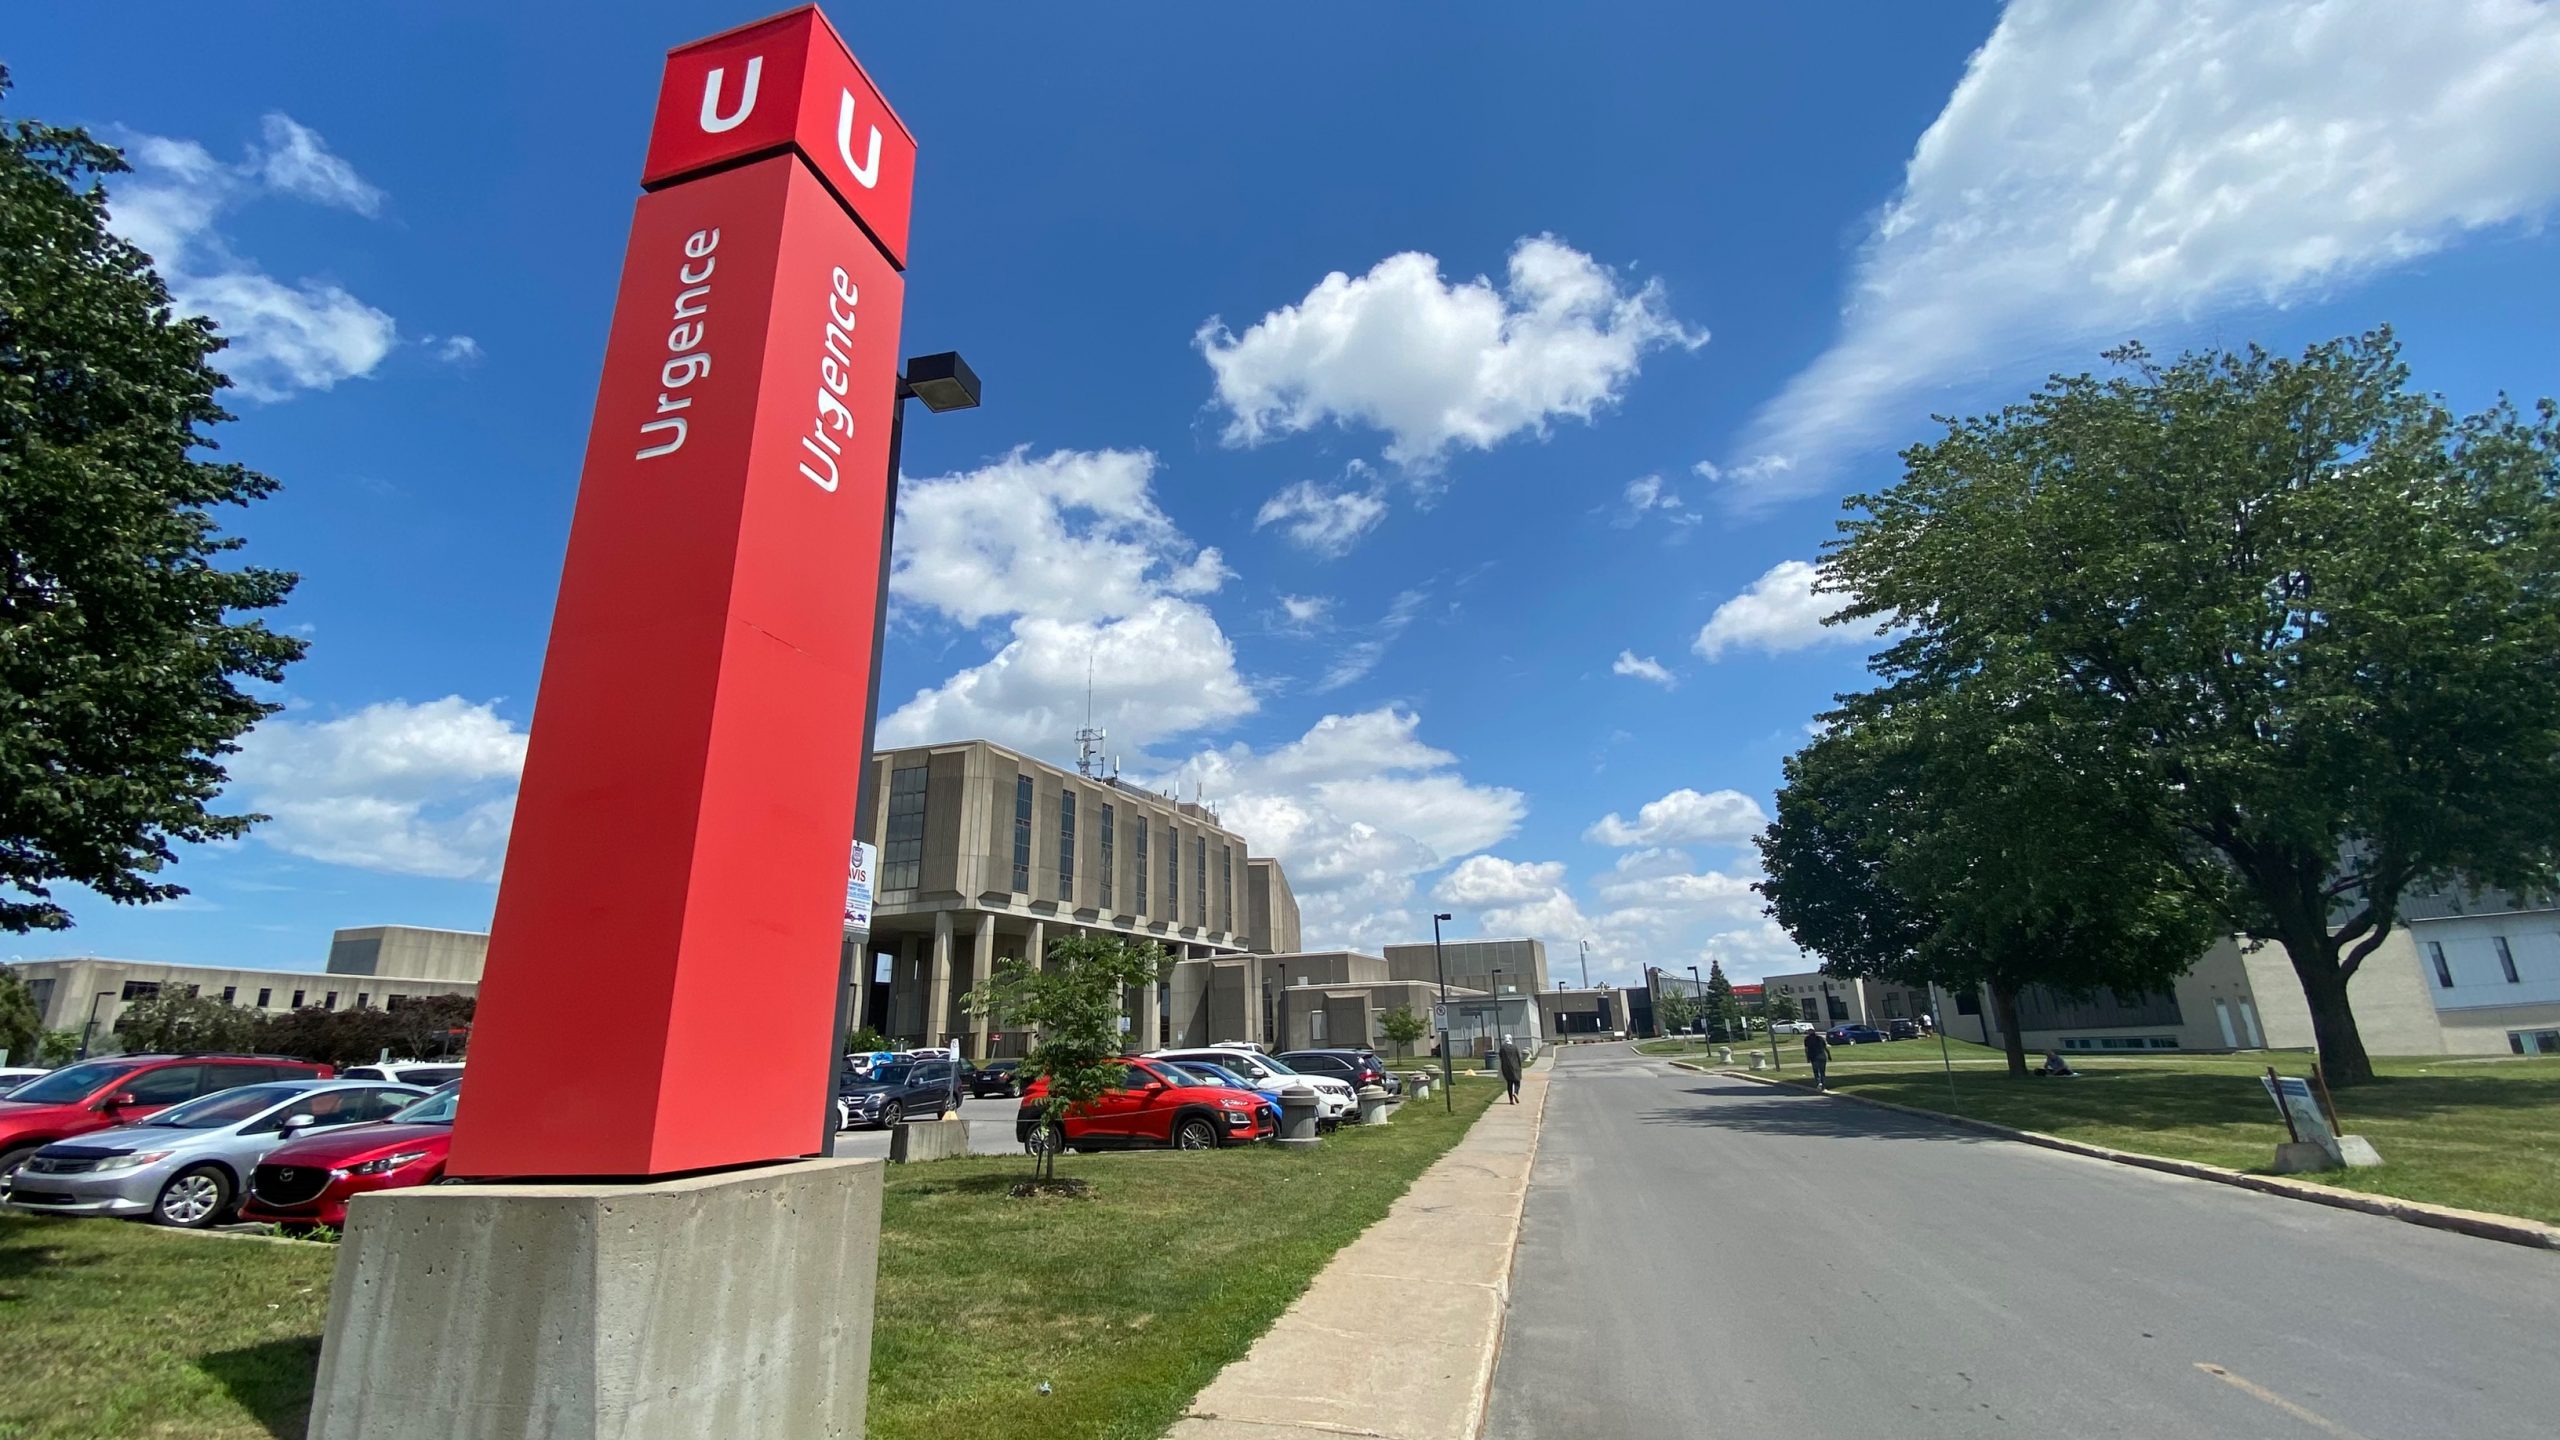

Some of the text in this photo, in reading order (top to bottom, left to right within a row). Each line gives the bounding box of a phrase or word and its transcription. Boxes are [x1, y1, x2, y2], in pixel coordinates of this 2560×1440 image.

[700, 56, 763, 133] U
[837, 87, 882, 189] U
[636, 226, 720, 460] Urgence
[799, 265, 859, 493] Urgence
